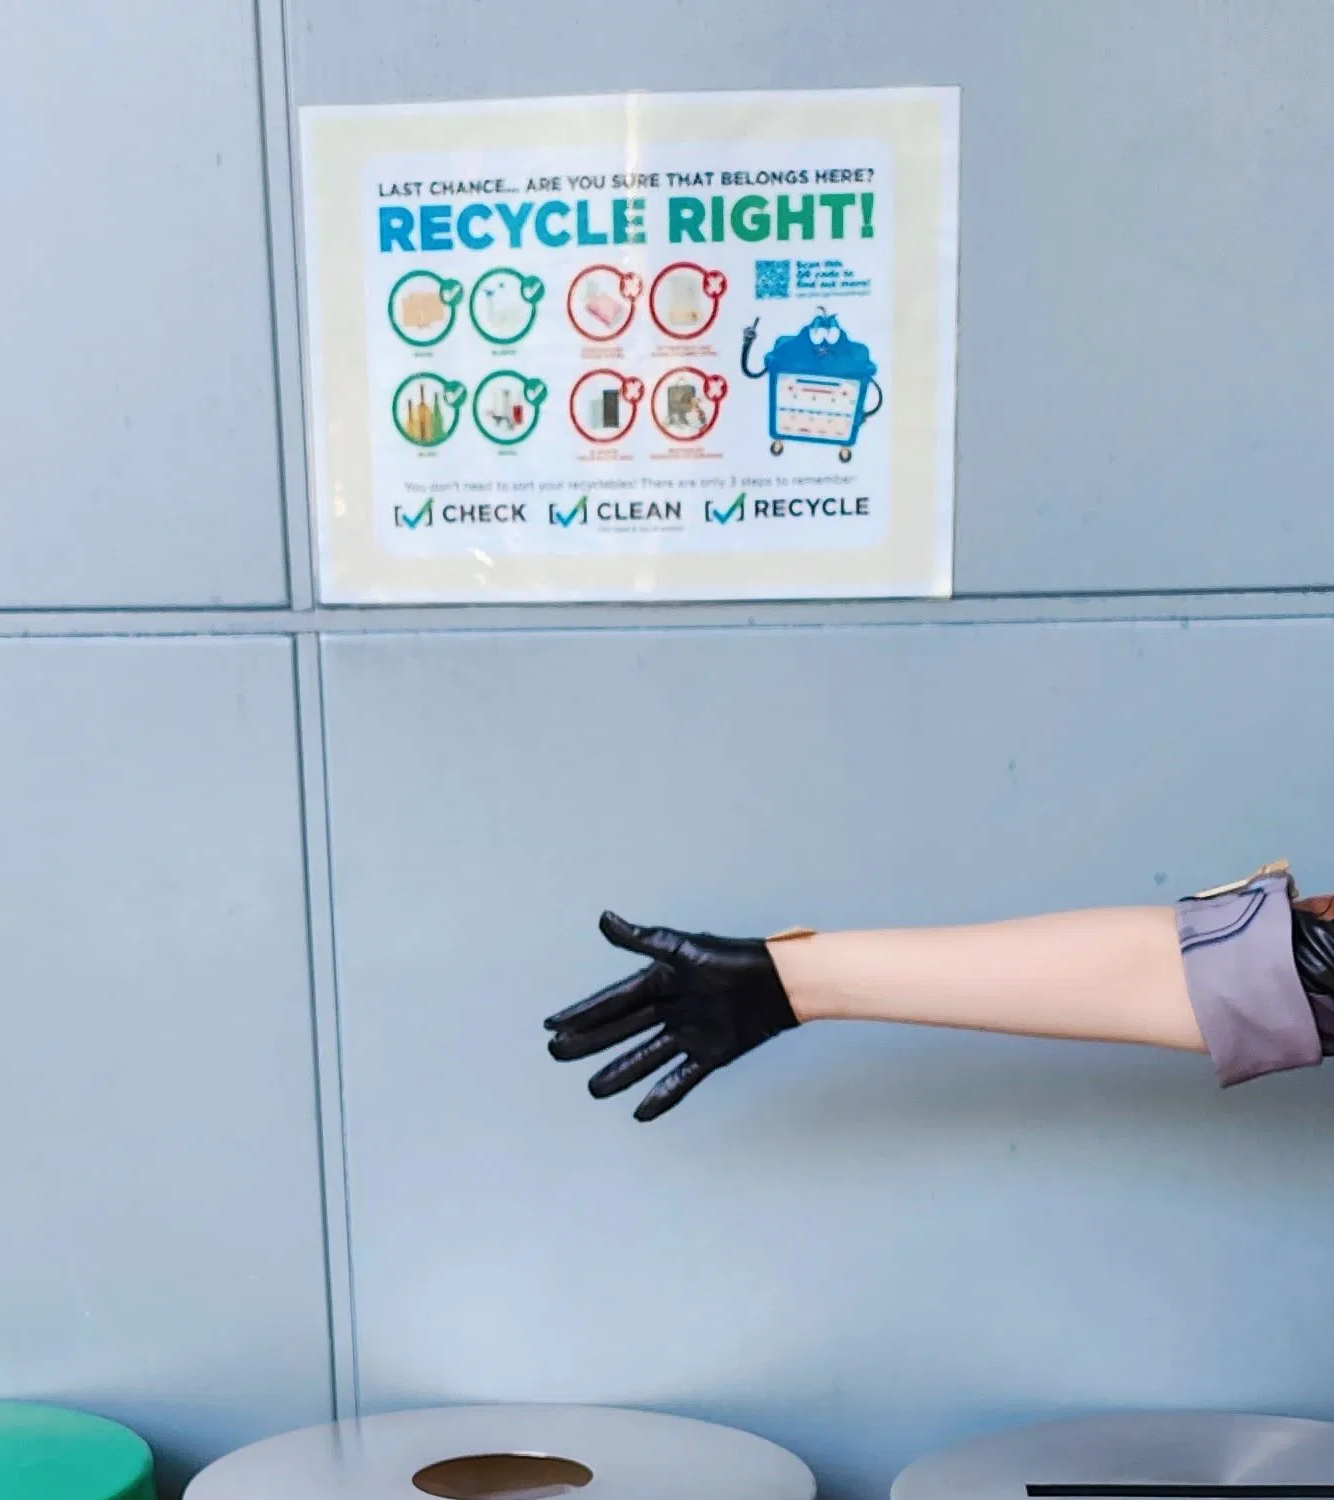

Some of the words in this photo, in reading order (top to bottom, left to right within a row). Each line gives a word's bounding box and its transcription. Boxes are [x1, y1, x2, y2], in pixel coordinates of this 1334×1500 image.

[378, 181, 423, 197] LAST
[526, 176, 562, 192] ARE
[567, 175, 606, 190] YOU
[611, 172, 660, 189] SURE
[667, 171, 714, 188] THAT
[720, 169, 809, 186] BELONGS
[816, 167, 874, 184] HERE?
[378, 197, 647, 252] RECYCLE
[668, 192, 875, 243] RIGHT!
[442, 503, 527, 523] CHECK
[597, 501, 682, 521] CLEAN
[754, 497, 870, 518] RECYCLE
